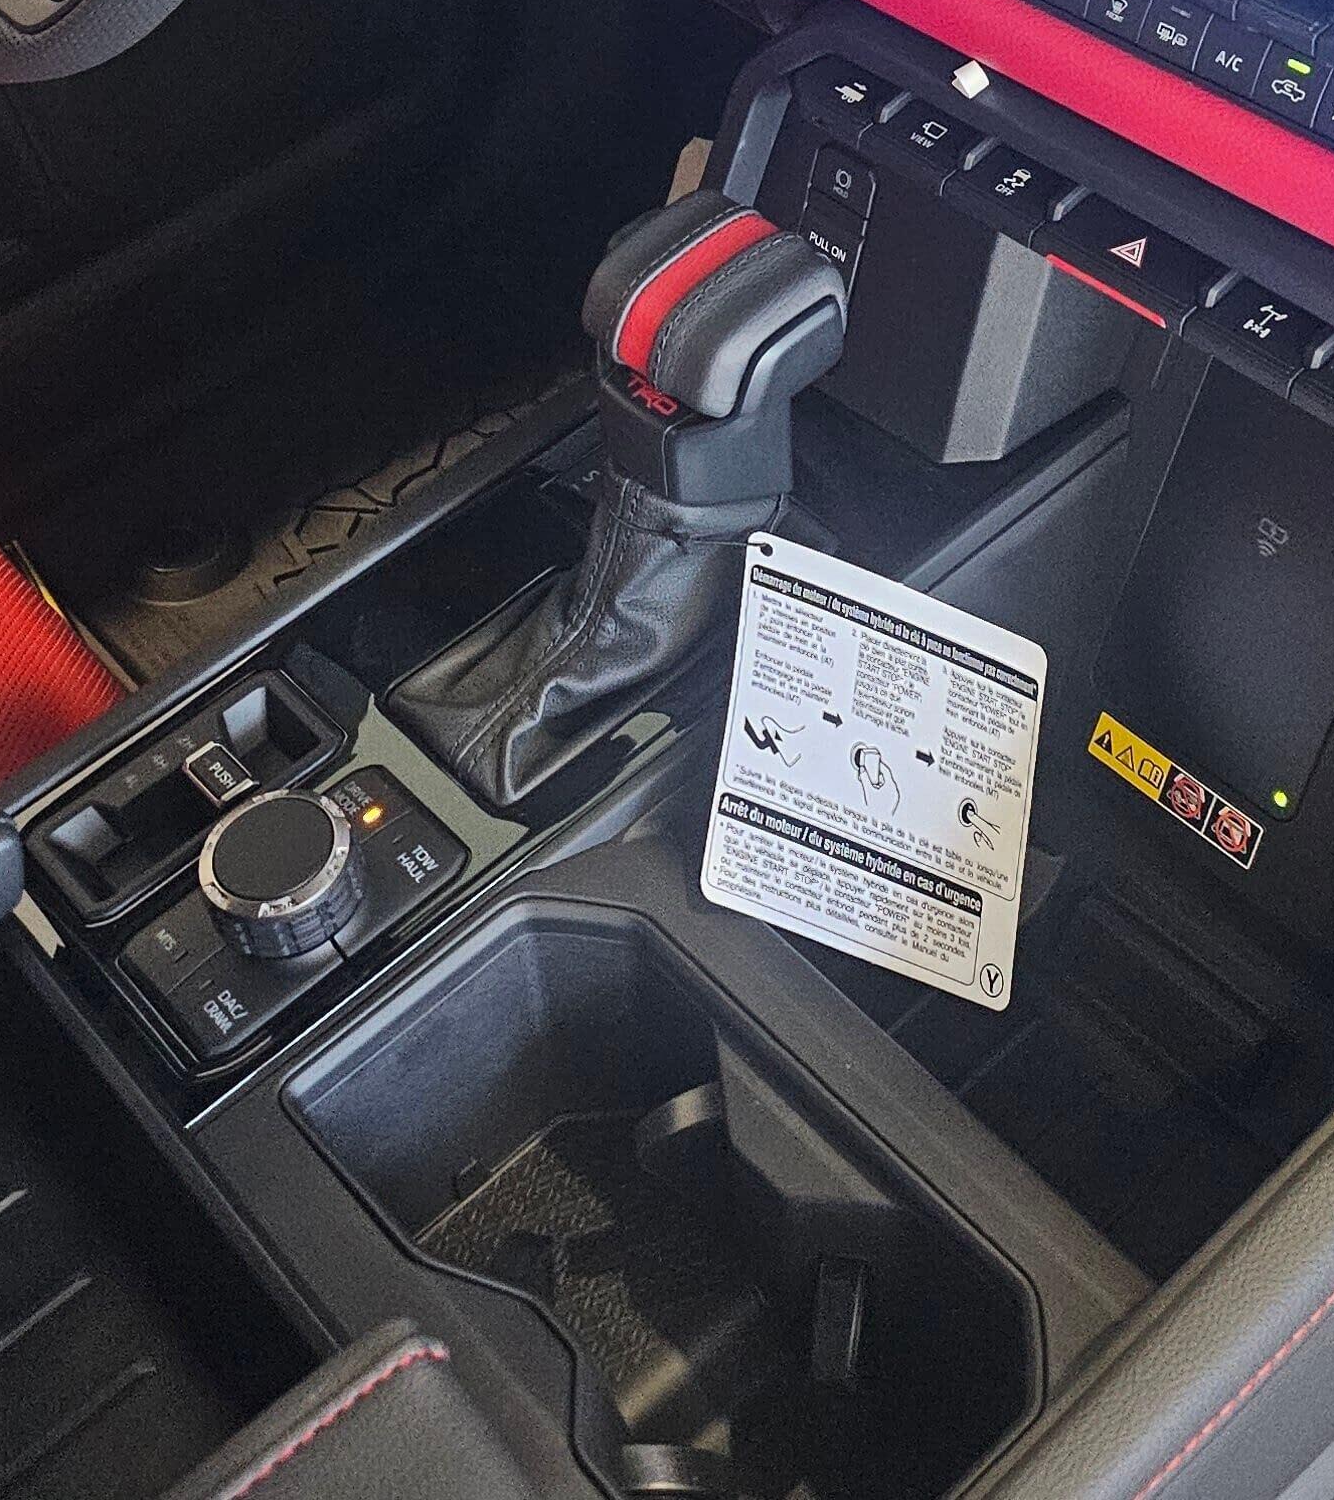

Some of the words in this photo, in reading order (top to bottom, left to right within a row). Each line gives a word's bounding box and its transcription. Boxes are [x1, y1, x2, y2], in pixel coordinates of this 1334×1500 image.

[1215, 50, 1243, 72] A/C
[910, 132, 934, 149] VIEW
[995, 183, 1015, 197] OFF
[809, 231, 831, 255] PULL
[831, 245, 847, 263] ON
[208, 762, 237, 789] PUSH
[345, 780, 374, 807] DRIVE
[397, 852, 426, 883] HAUL
[411, 844, 439, 871] TOW
[720, 793, 749, 819] Arrêt
[749, 804, 764, 825] du
[764, 811, 803, 840] moteur
[801, 824, 809, 843] /
[808, 828, 822, 848] du
[823, 834, 864, 867] système
[864, 851, 902, 883] hybride
[902, 868, 916, 886] en
[916, 874, 934, 894] cas
[934, 880, 981, 915] d'urgence
[156, 928, 177, 951] MTS
[985, 968, 1000, 993] Y
[217, 989, 249, 1020] DAC/
